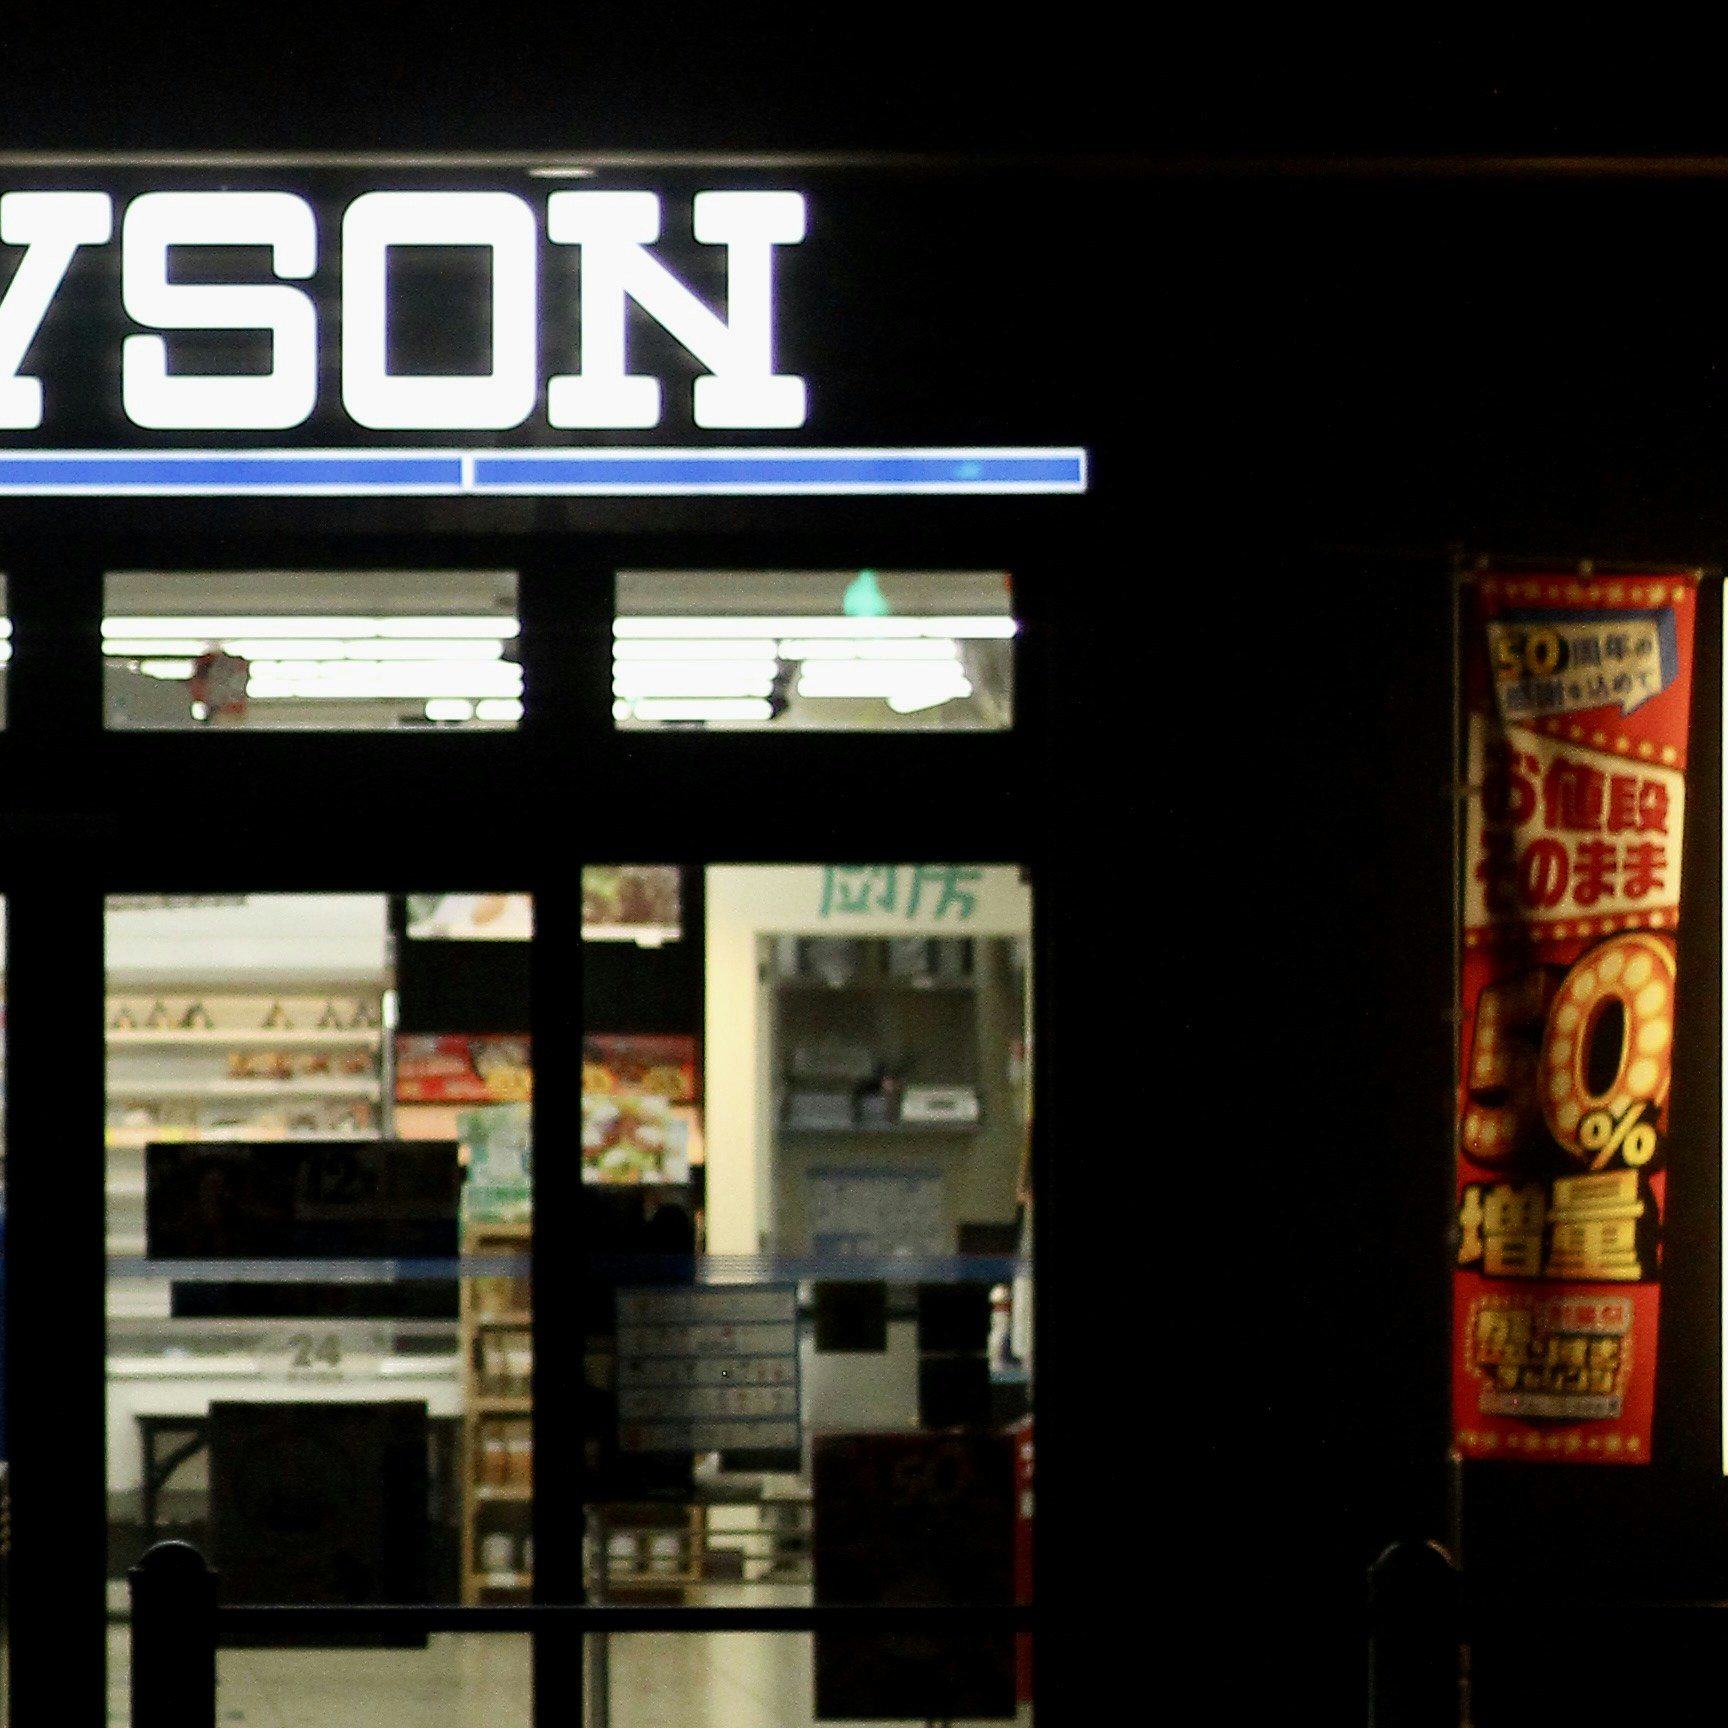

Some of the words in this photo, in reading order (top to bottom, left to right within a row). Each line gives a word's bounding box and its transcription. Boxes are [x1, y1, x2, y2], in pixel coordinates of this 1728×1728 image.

[1483, 740, 1669, 834] お値段
[1476, 831, 1666, 914] そのまま
[1457, 1168, 1645, 1281] 増量
